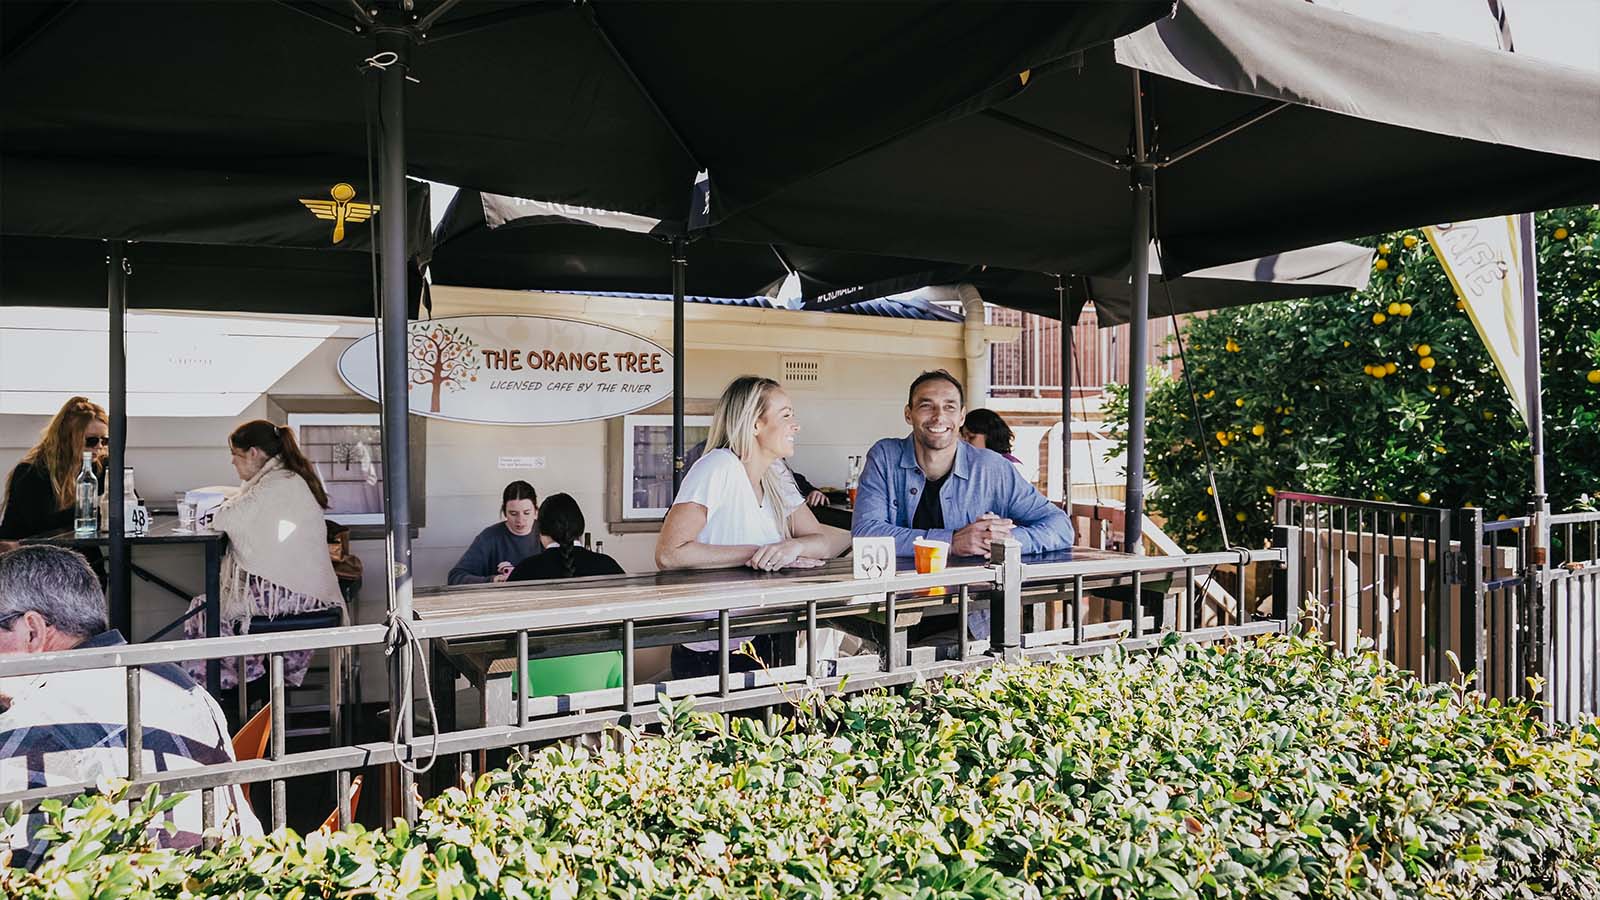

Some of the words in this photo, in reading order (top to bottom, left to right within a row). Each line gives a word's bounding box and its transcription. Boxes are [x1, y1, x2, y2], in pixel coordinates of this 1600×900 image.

[1436, 223, 1508, 297] AFE
[481, 349, 523, 371] THE
[527, 350, 611, 373] ORANGE
[614, 352, 664, 374] TREE
[490, 381, 542, 391] LICENSED
[546, 382, 574, 392] CAFE
[577, 383, 593, 393] BY
[597, 383, 617, 393] THE
[621, 384, 651, 393] RIVER
[132, 509, 146, 527] 48
[861, 544, 889, 572] 50
